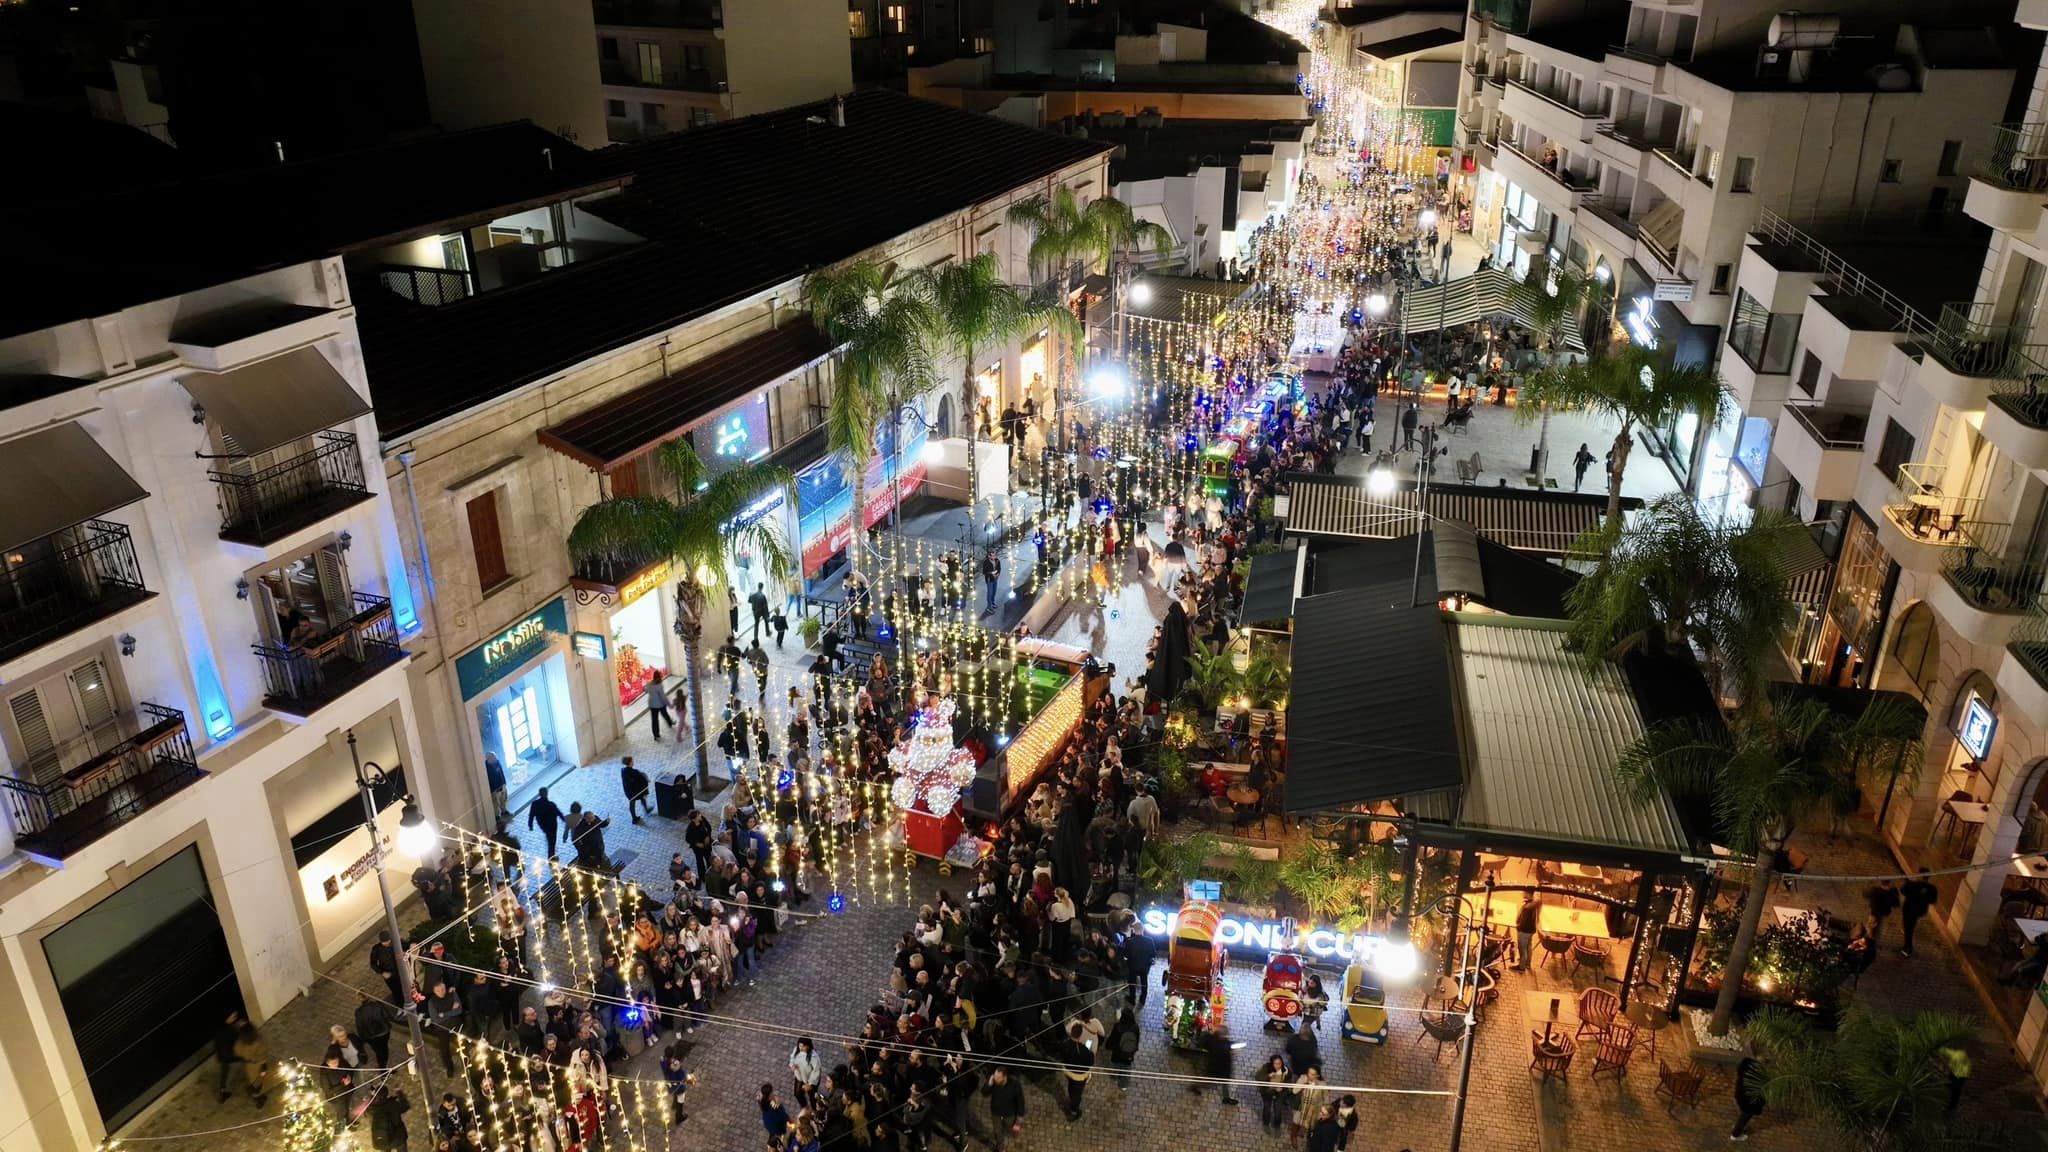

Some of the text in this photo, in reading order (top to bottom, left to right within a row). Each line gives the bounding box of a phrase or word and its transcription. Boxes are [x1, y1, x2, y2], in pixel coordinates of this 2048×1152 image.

[340, 834, 391, 881] ΕΝΟΙΚΙΑΖΑΙ
[1143, 909, 1389, 963] SOND CUP
